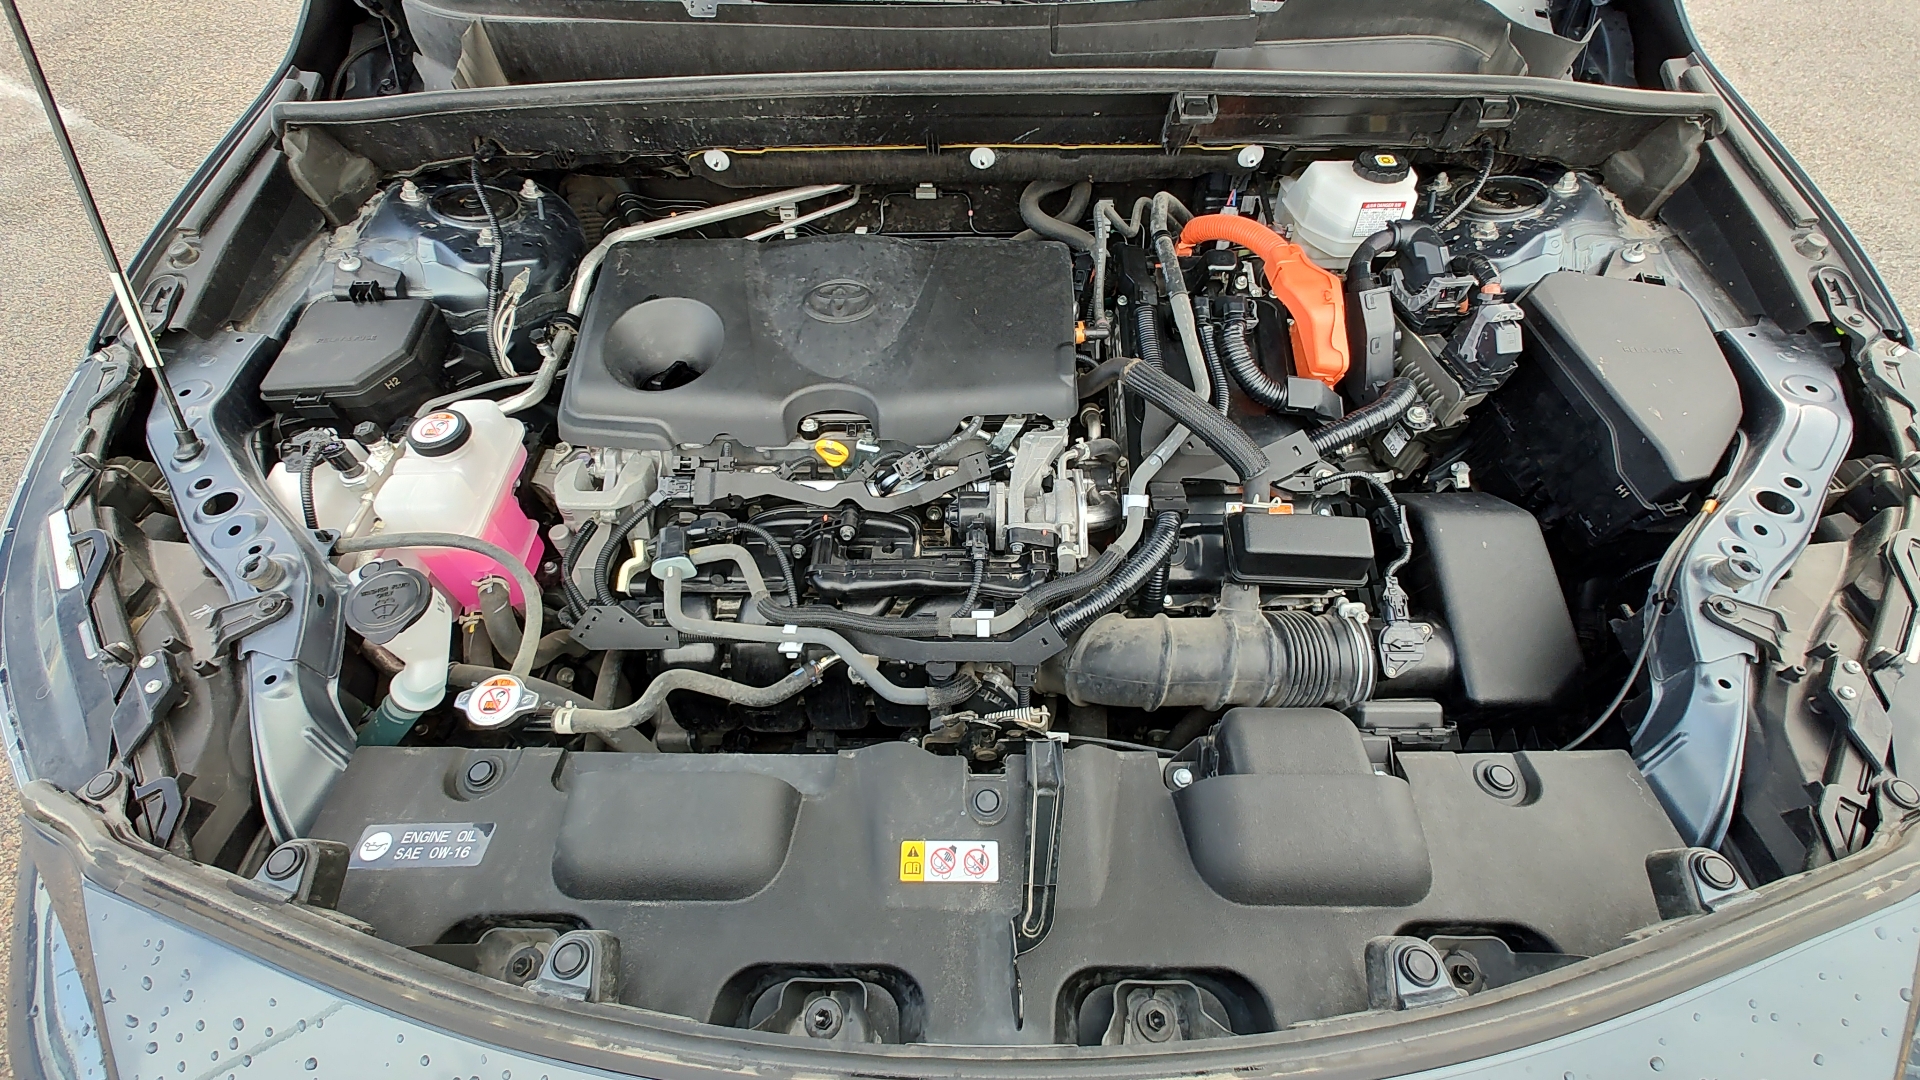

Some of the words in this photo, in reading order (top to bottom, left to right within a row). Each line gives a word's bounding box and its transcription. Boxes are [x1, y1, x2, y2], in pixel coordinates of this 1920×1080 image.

[384, 376, 401, 390] H2
[1614, 484, 1630, 499] H1
[401, 830, 451, 844] ENGINE
[456, 830, 477, 842] OIL
[393, 847, 424, 860] SAE
